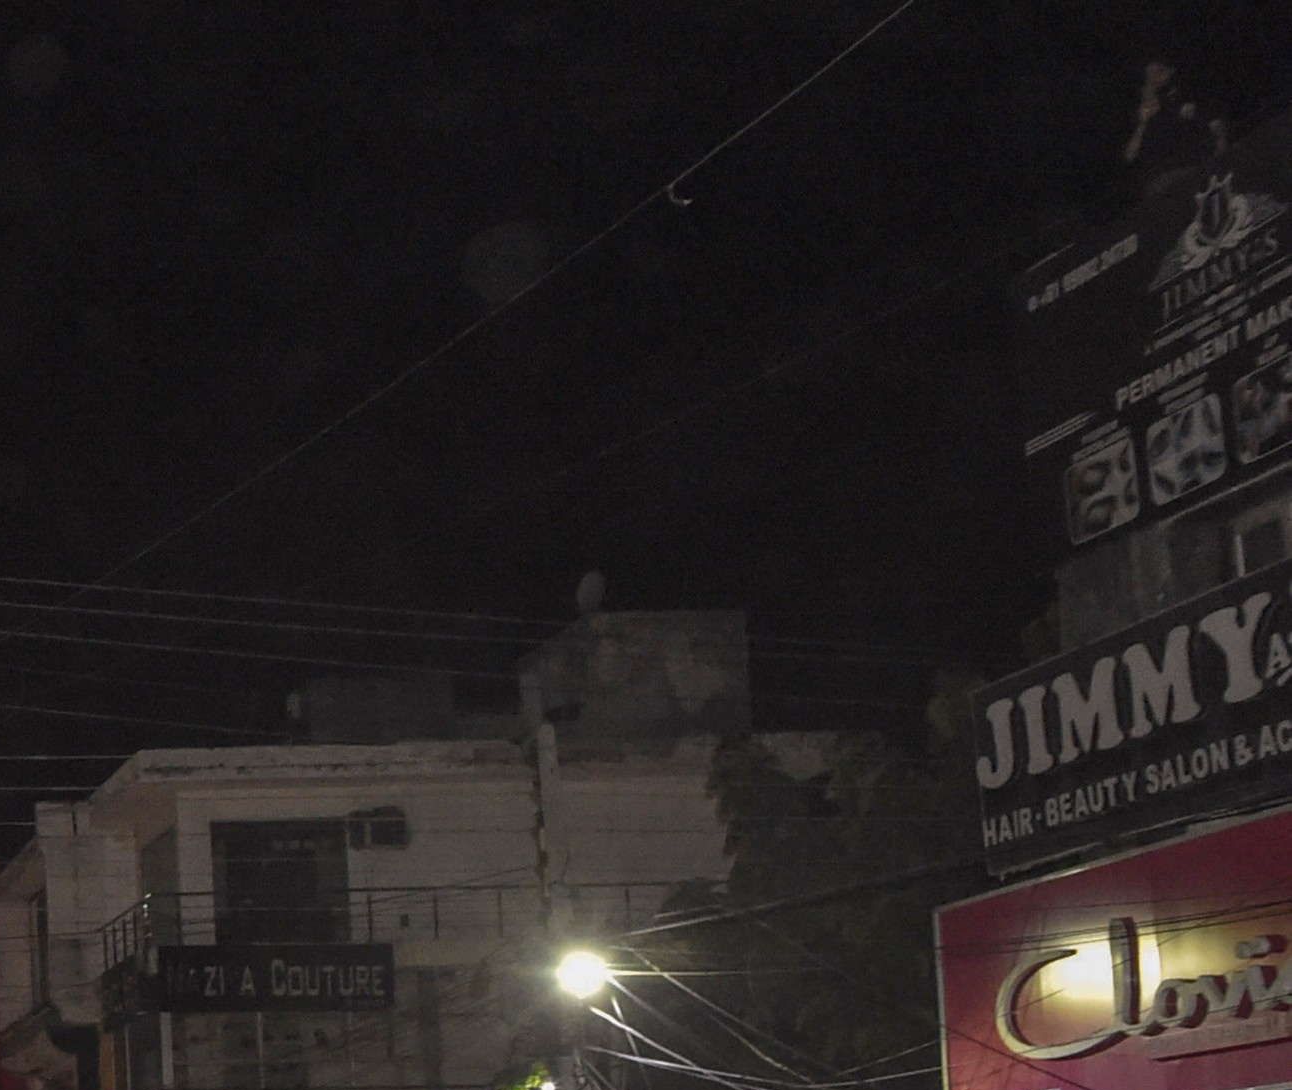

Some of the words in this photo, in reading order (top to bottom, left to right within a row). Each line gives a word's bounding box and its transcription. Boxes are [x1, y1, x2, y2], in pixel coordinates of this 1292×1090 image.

[1116, 325, 1240, 411] PERMANENT
[976, 592, 1272, 790] JIMMY
[994, 917, 1292, 1061] Clovi
